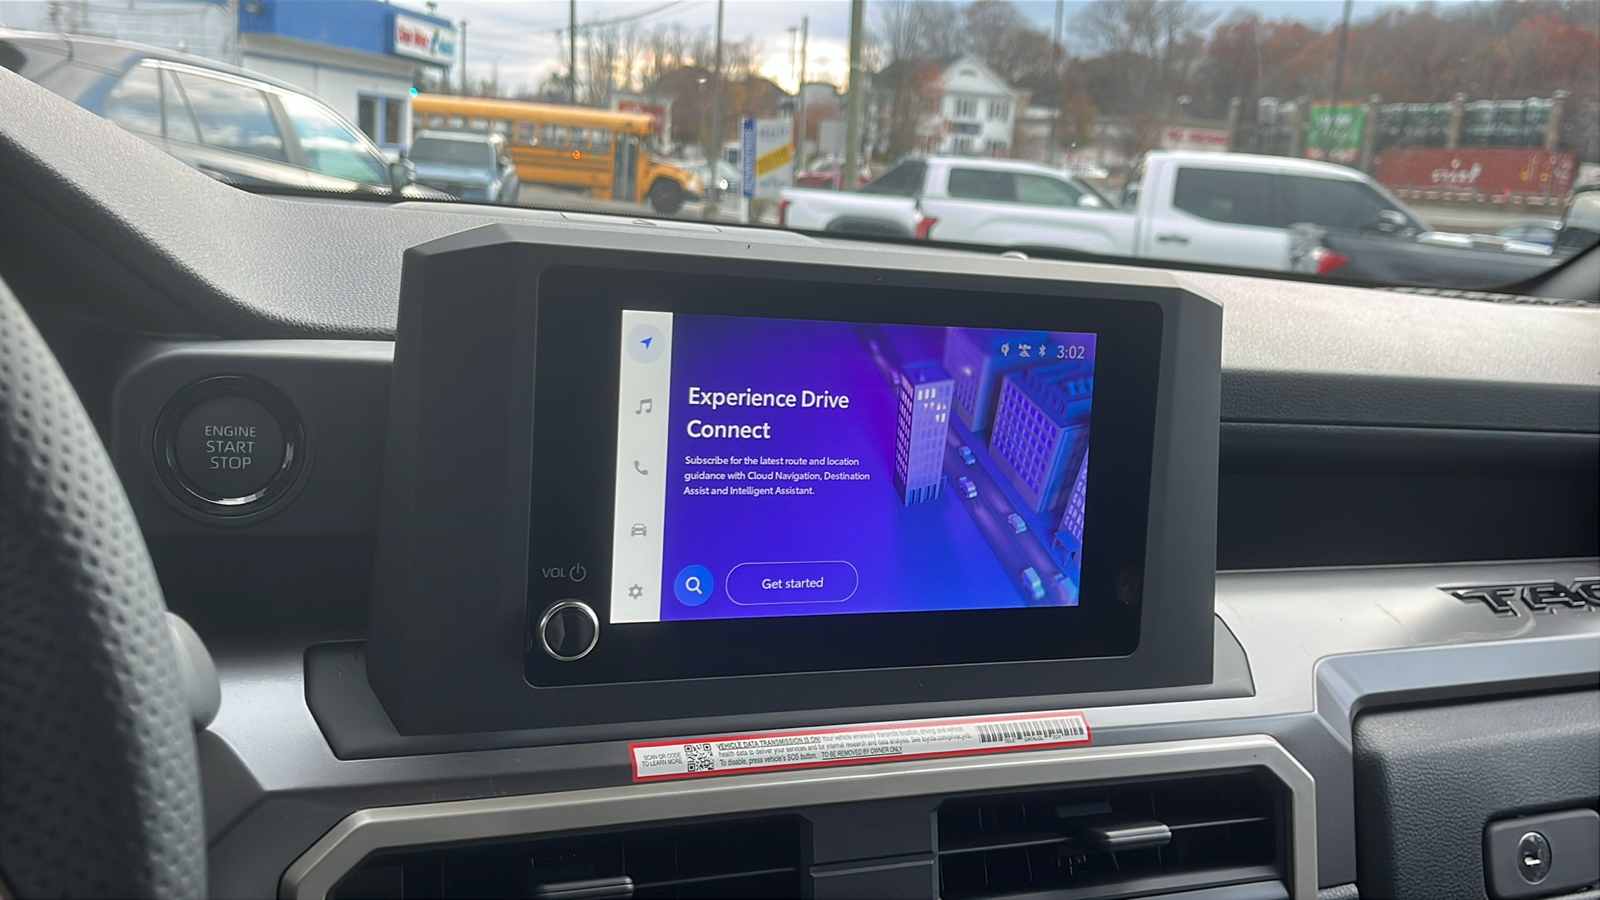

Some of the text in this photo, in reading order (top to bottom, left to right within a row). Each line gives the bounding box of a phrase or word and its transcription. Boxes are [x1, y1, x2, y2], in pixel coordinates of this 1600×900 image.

[1056, 345, 1085, 359] 3:02
[688, 386, 850, 410] Experience Drive
[205, 425, 257, 437] ENGINE
[686, 419, 771, 439] Connect
[206, 440, 255, 454] START
[210, 456, 252, 469] STOP
[685, 455, 859, 466] Subscribe for the latest route and location
[684, 471, 870, 482] guidance with Cloud Navigation, Destination
[683, 486, 815, 497] Assist and Intelligent Assistant.
[542, 567, 565, 578] VOL
[761, 577, 824, 590] Get started
[716, 741, 741, 749] VEHICLE
[759, 737, 802, 746] TRANSMISSION
[727, 757, 747, 767] disable,
[748, 756, 763, 765] press
[763, 754, 786, 762] vehicle's
[800, 751, 817, 759] button.
[837, 748, 862, 757] REMOVED
[870, 746, 889, 754] OWNER
[773, 747, 784, 755] your
